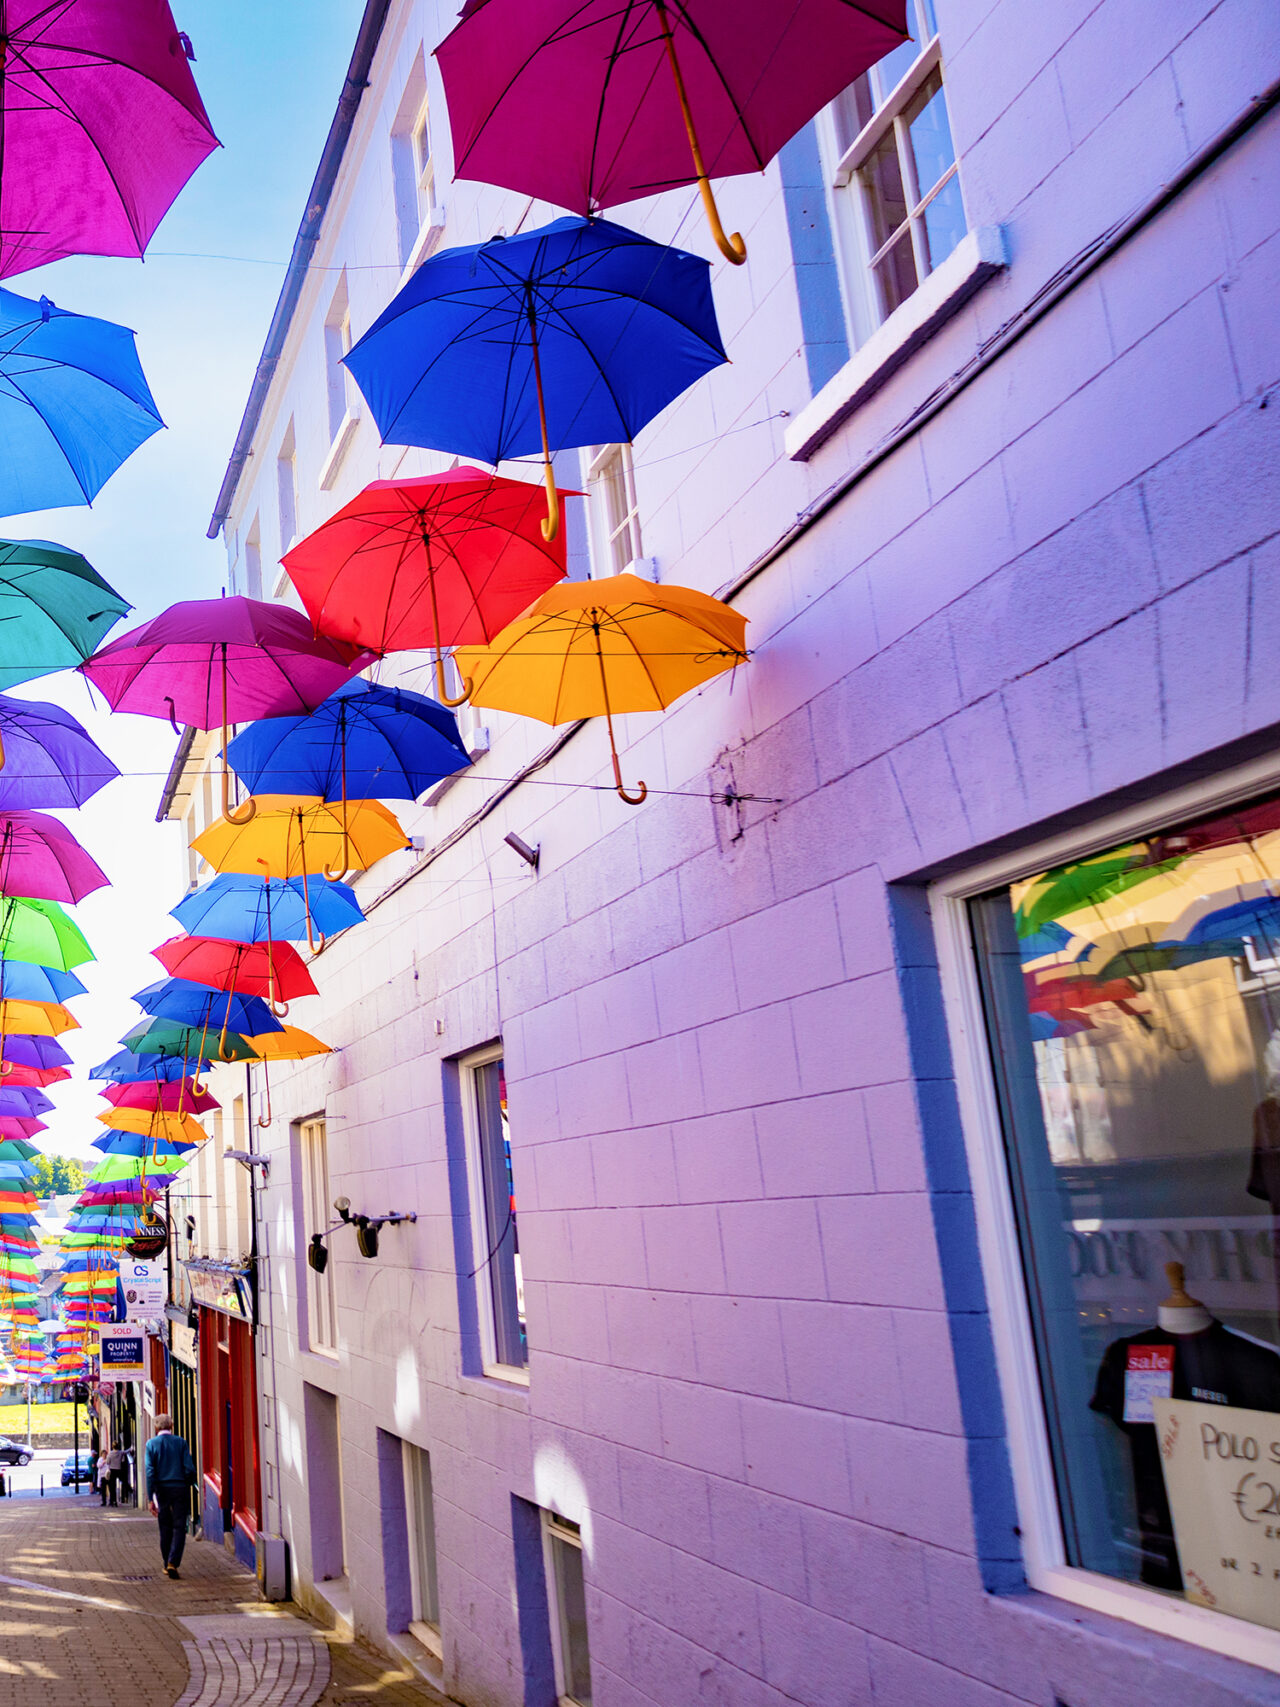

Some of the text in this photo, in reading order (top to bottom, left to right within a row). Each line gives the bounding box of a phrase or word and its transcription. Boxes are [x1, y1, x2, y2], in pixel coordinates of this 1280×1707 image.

[133, 1265, 149, 1277] CS
[107, 1342, 138, 1351] QUINN
[1127, 1351, 1170, 1370] sale
[1200, 1422, 1260, 1462] POLO
